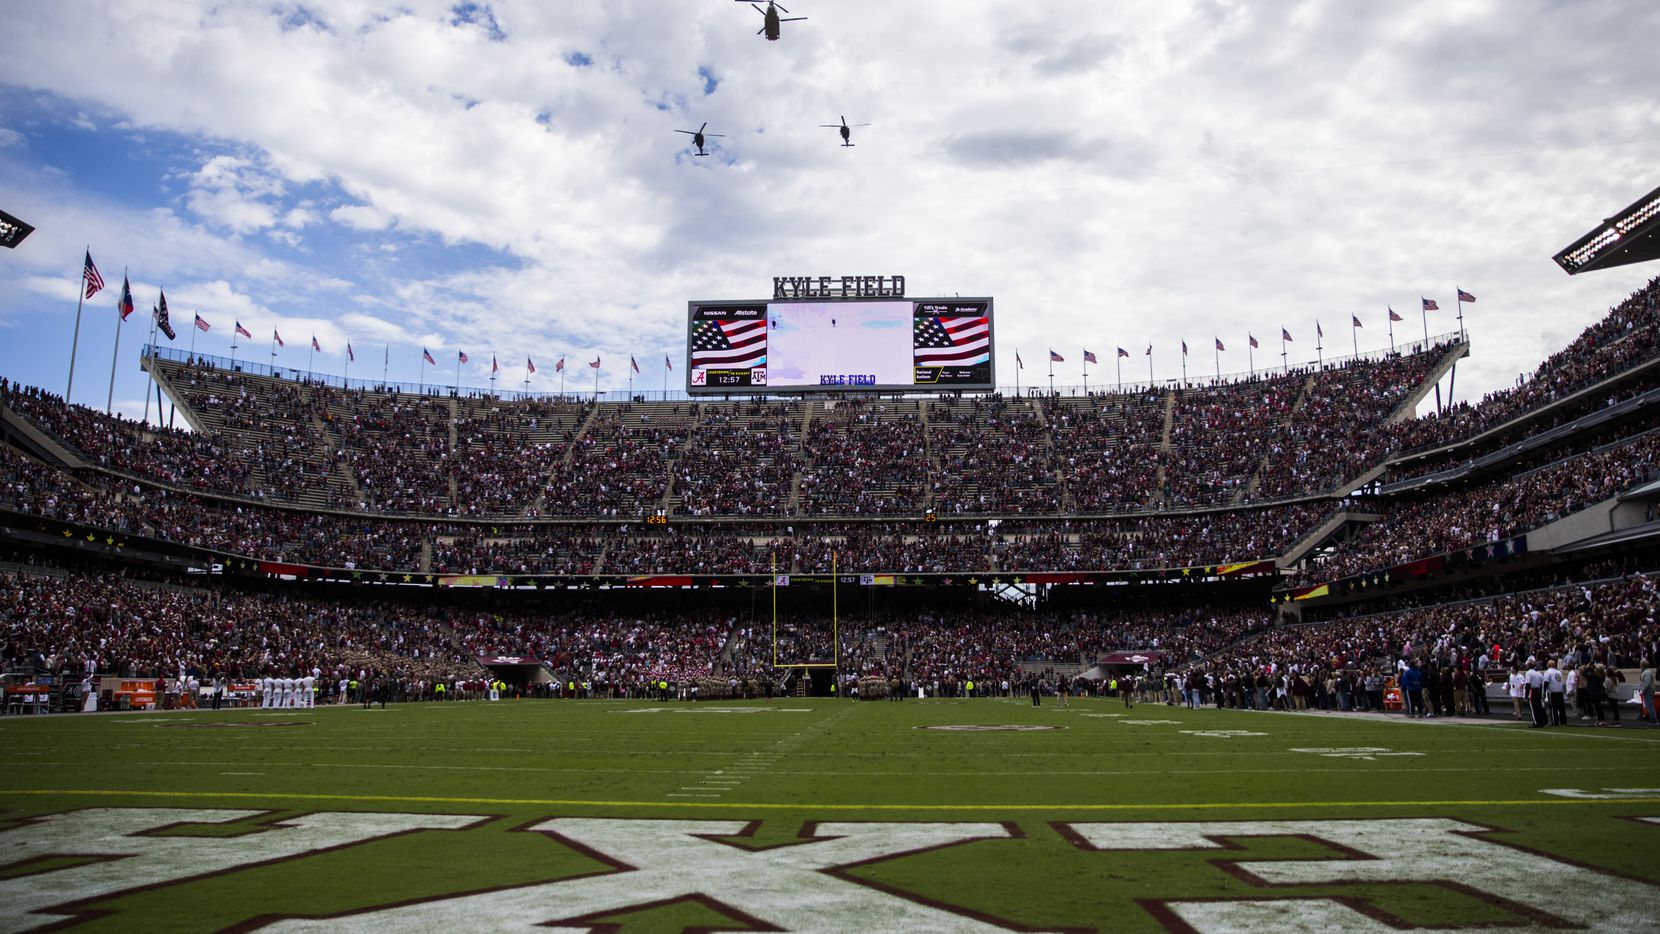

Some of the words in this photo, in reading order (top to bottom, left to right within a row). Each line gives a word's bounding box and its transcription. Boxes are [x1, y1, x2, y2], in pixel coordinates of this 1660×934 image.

[773, 276, 831, 297] KYLE
[841, 275, 905, 296] FIELD
[820, 374, 845, 385] KYLE
[848, 374, 876, 385] FIELD
